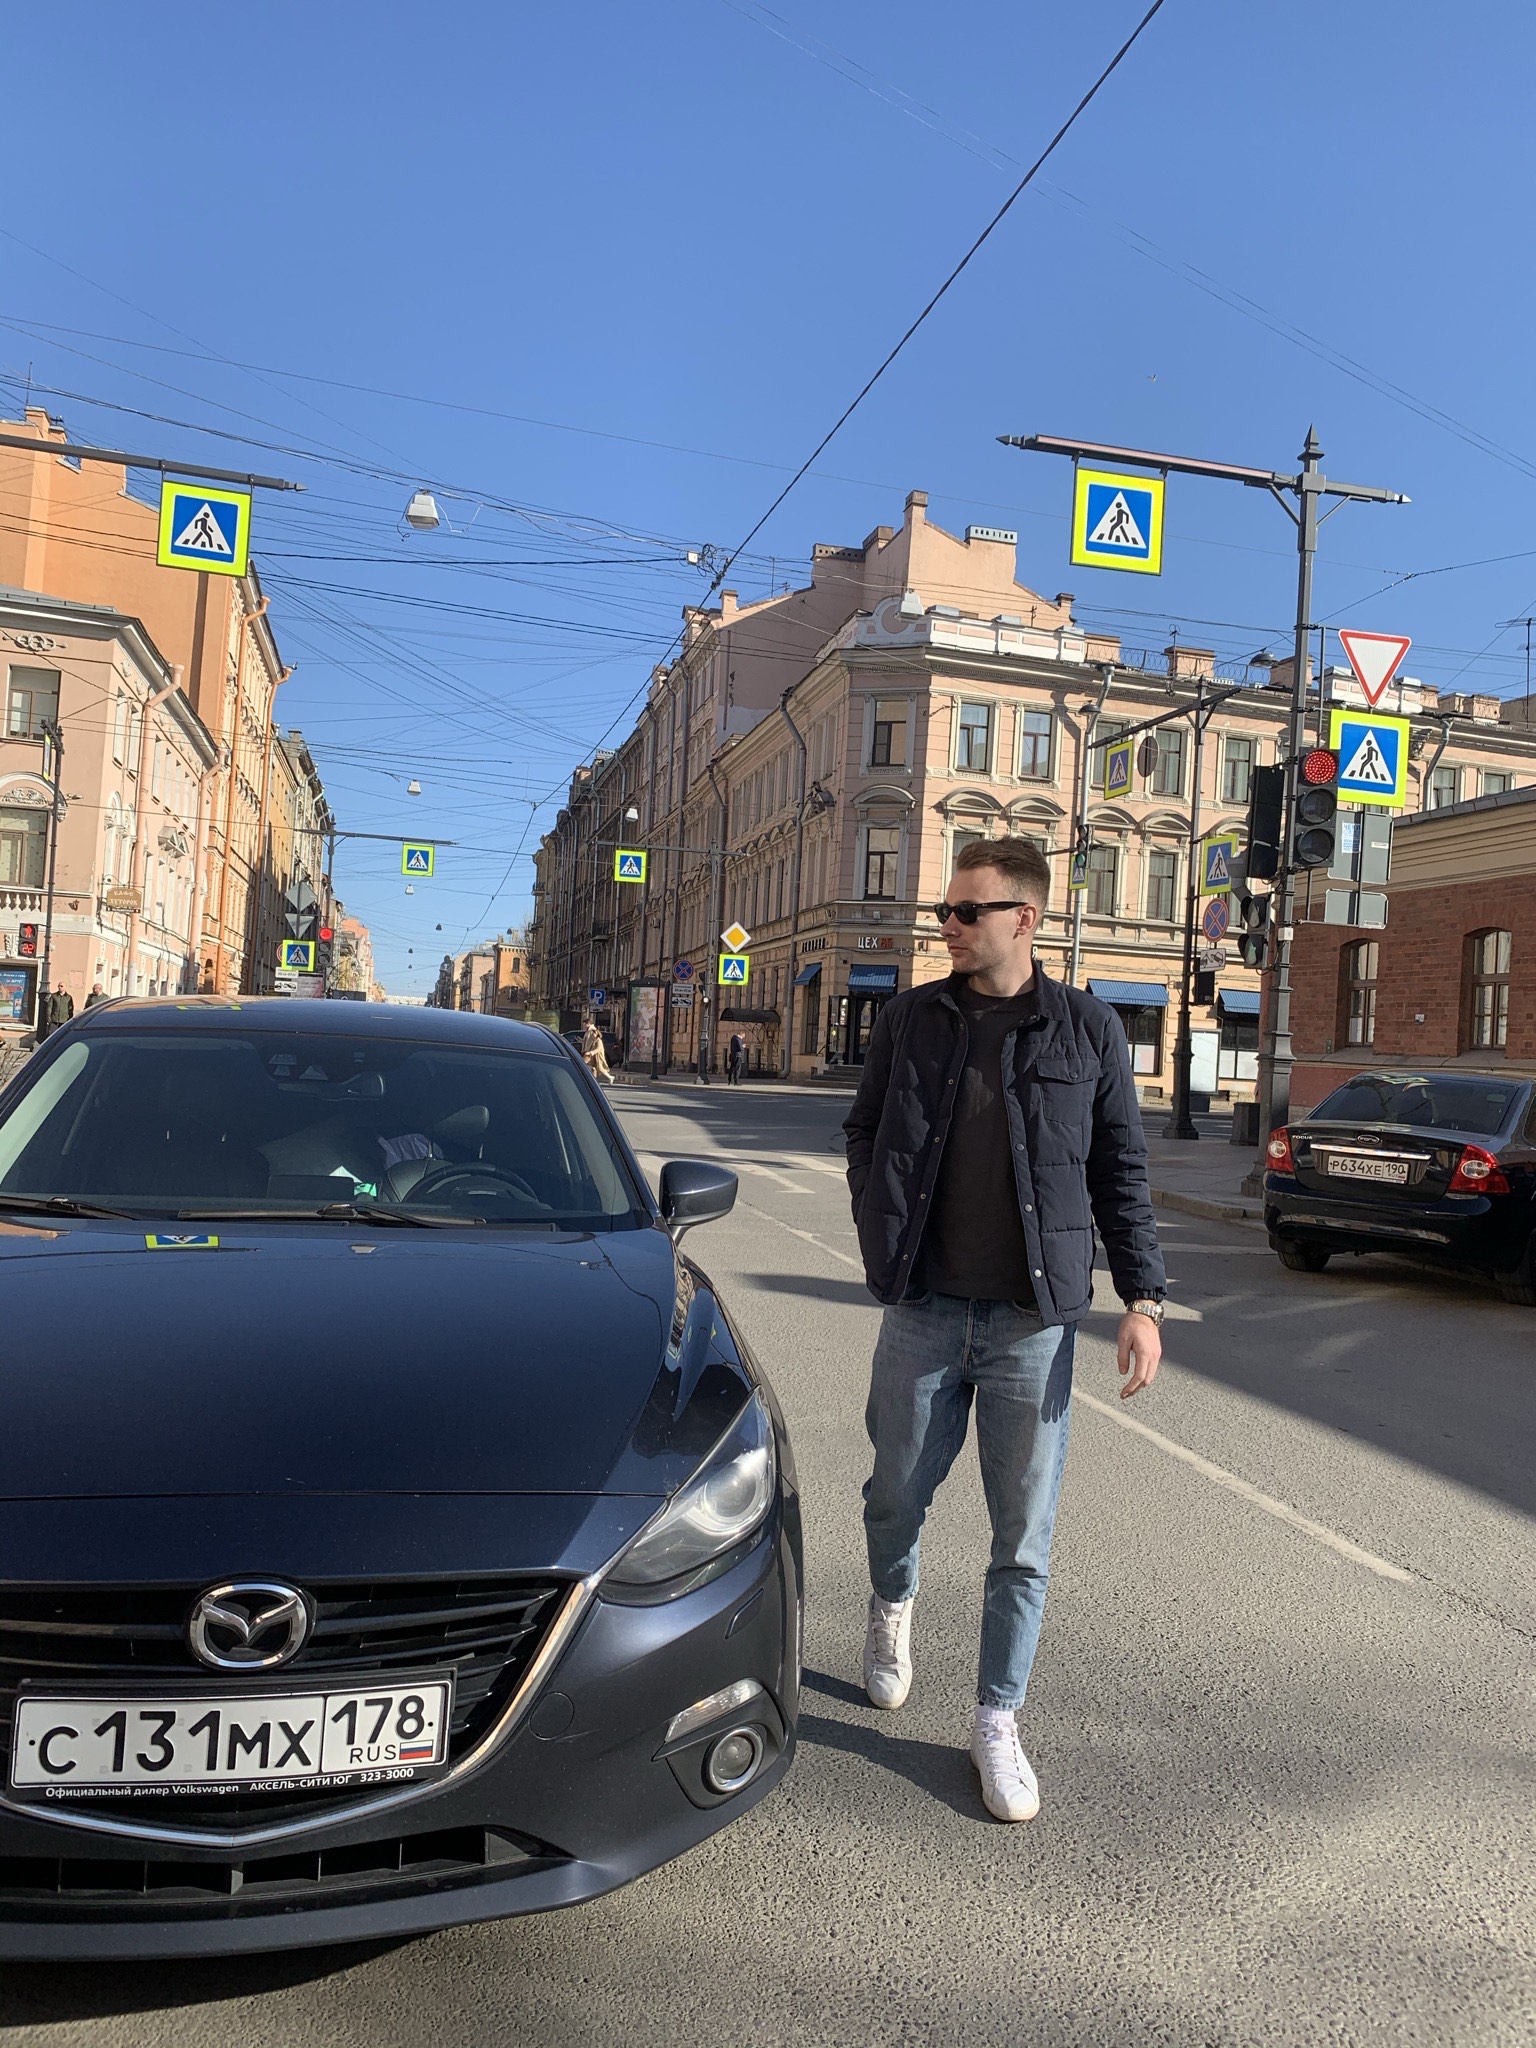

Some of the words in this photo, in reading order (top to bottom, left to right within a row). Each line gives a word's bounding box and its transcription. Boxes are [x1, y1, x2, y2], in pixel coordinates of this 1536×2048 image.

[22, 943, 34, 954] 22
[857, 936, 878, 949] ЦЕХ
[331, 1695, 425, 1745] 178
[350, 1744, 396, 1763] RUS
[46, 1786, 132, 1798] Официальный
[133, 1786, 170, 1797] дилер
[172, 1784, 239, 1795] Volkswagen
[250, 1777, 331, 1791] АКСЕЛЬ-СИТИ
[333, 1775, 352, 1788] ЮГ
[360, 1768, 414, 1783] 323-3000
